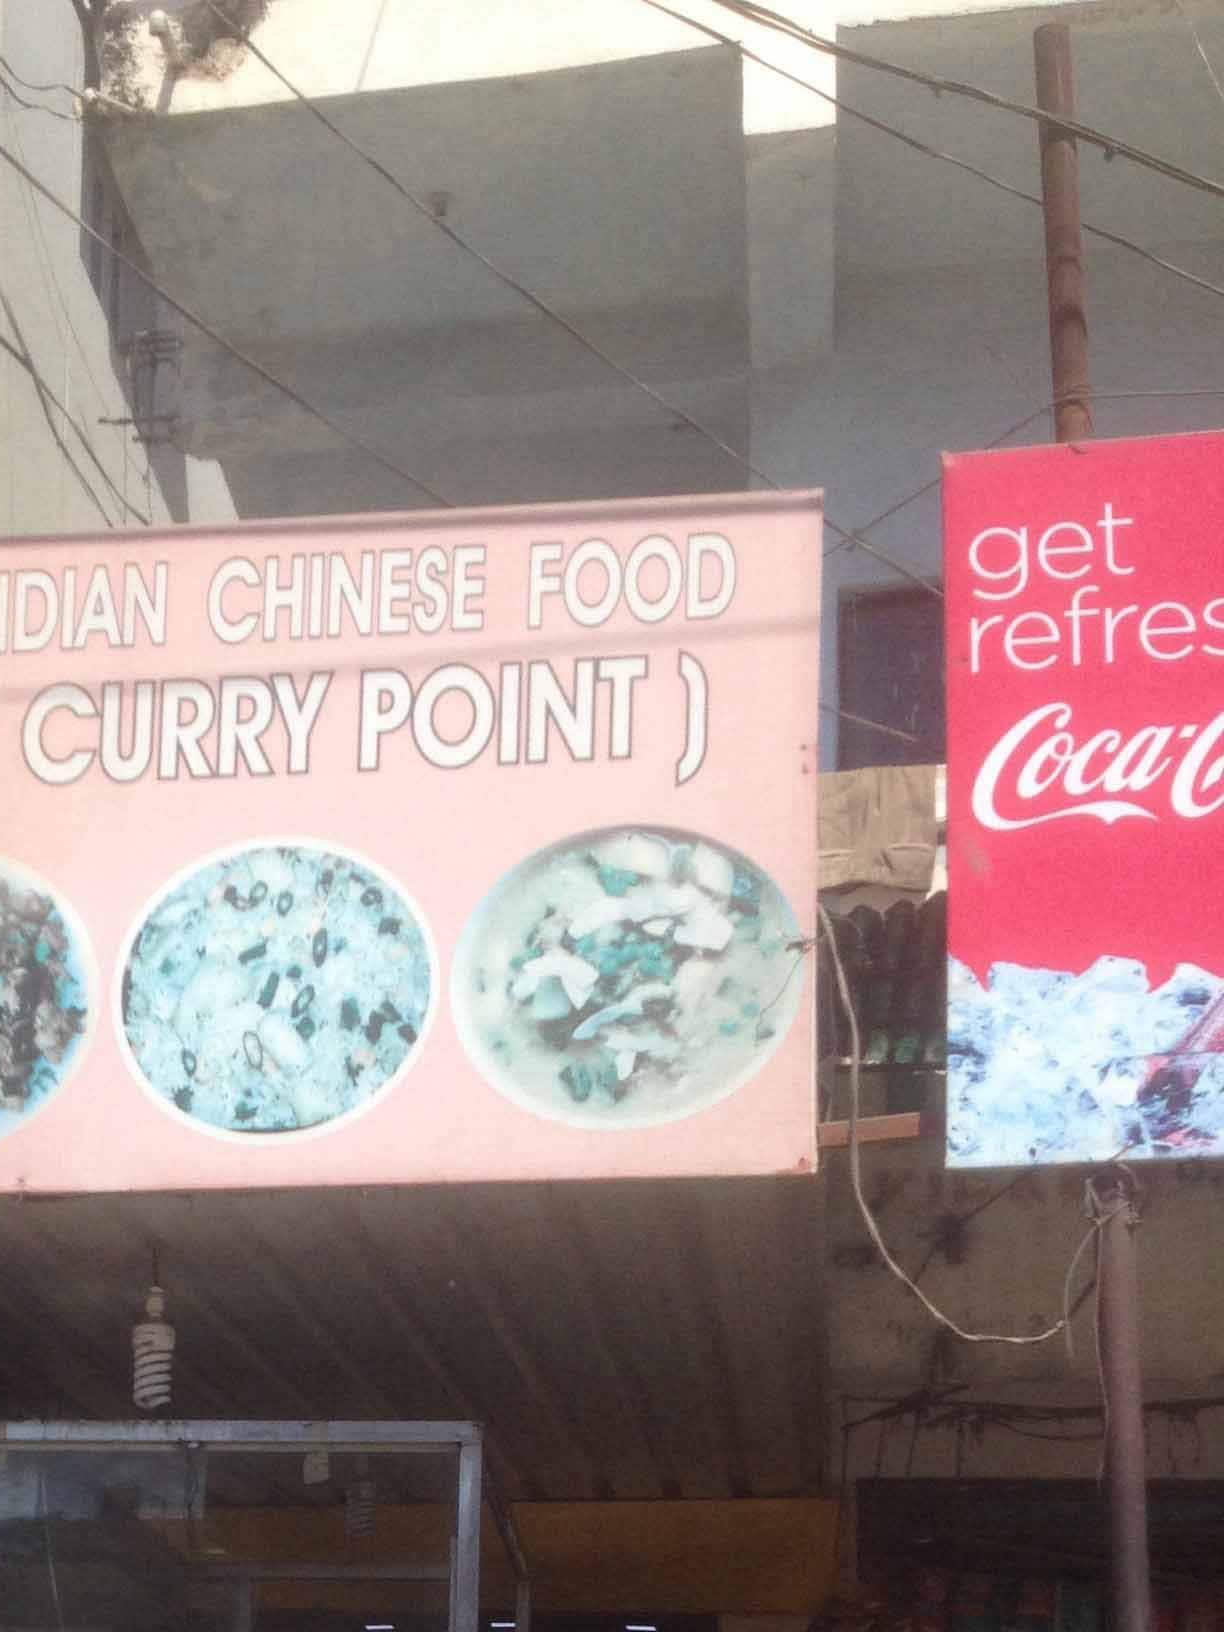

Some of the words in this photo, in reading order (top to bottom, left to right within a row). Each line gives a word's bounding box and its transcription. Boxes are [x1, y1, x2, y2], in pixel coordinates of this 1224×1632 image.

[207, 543, 487, 645] CHINESE
[527, 532, 736, 630] FOOD
[969, 503, 1135, 600] get
